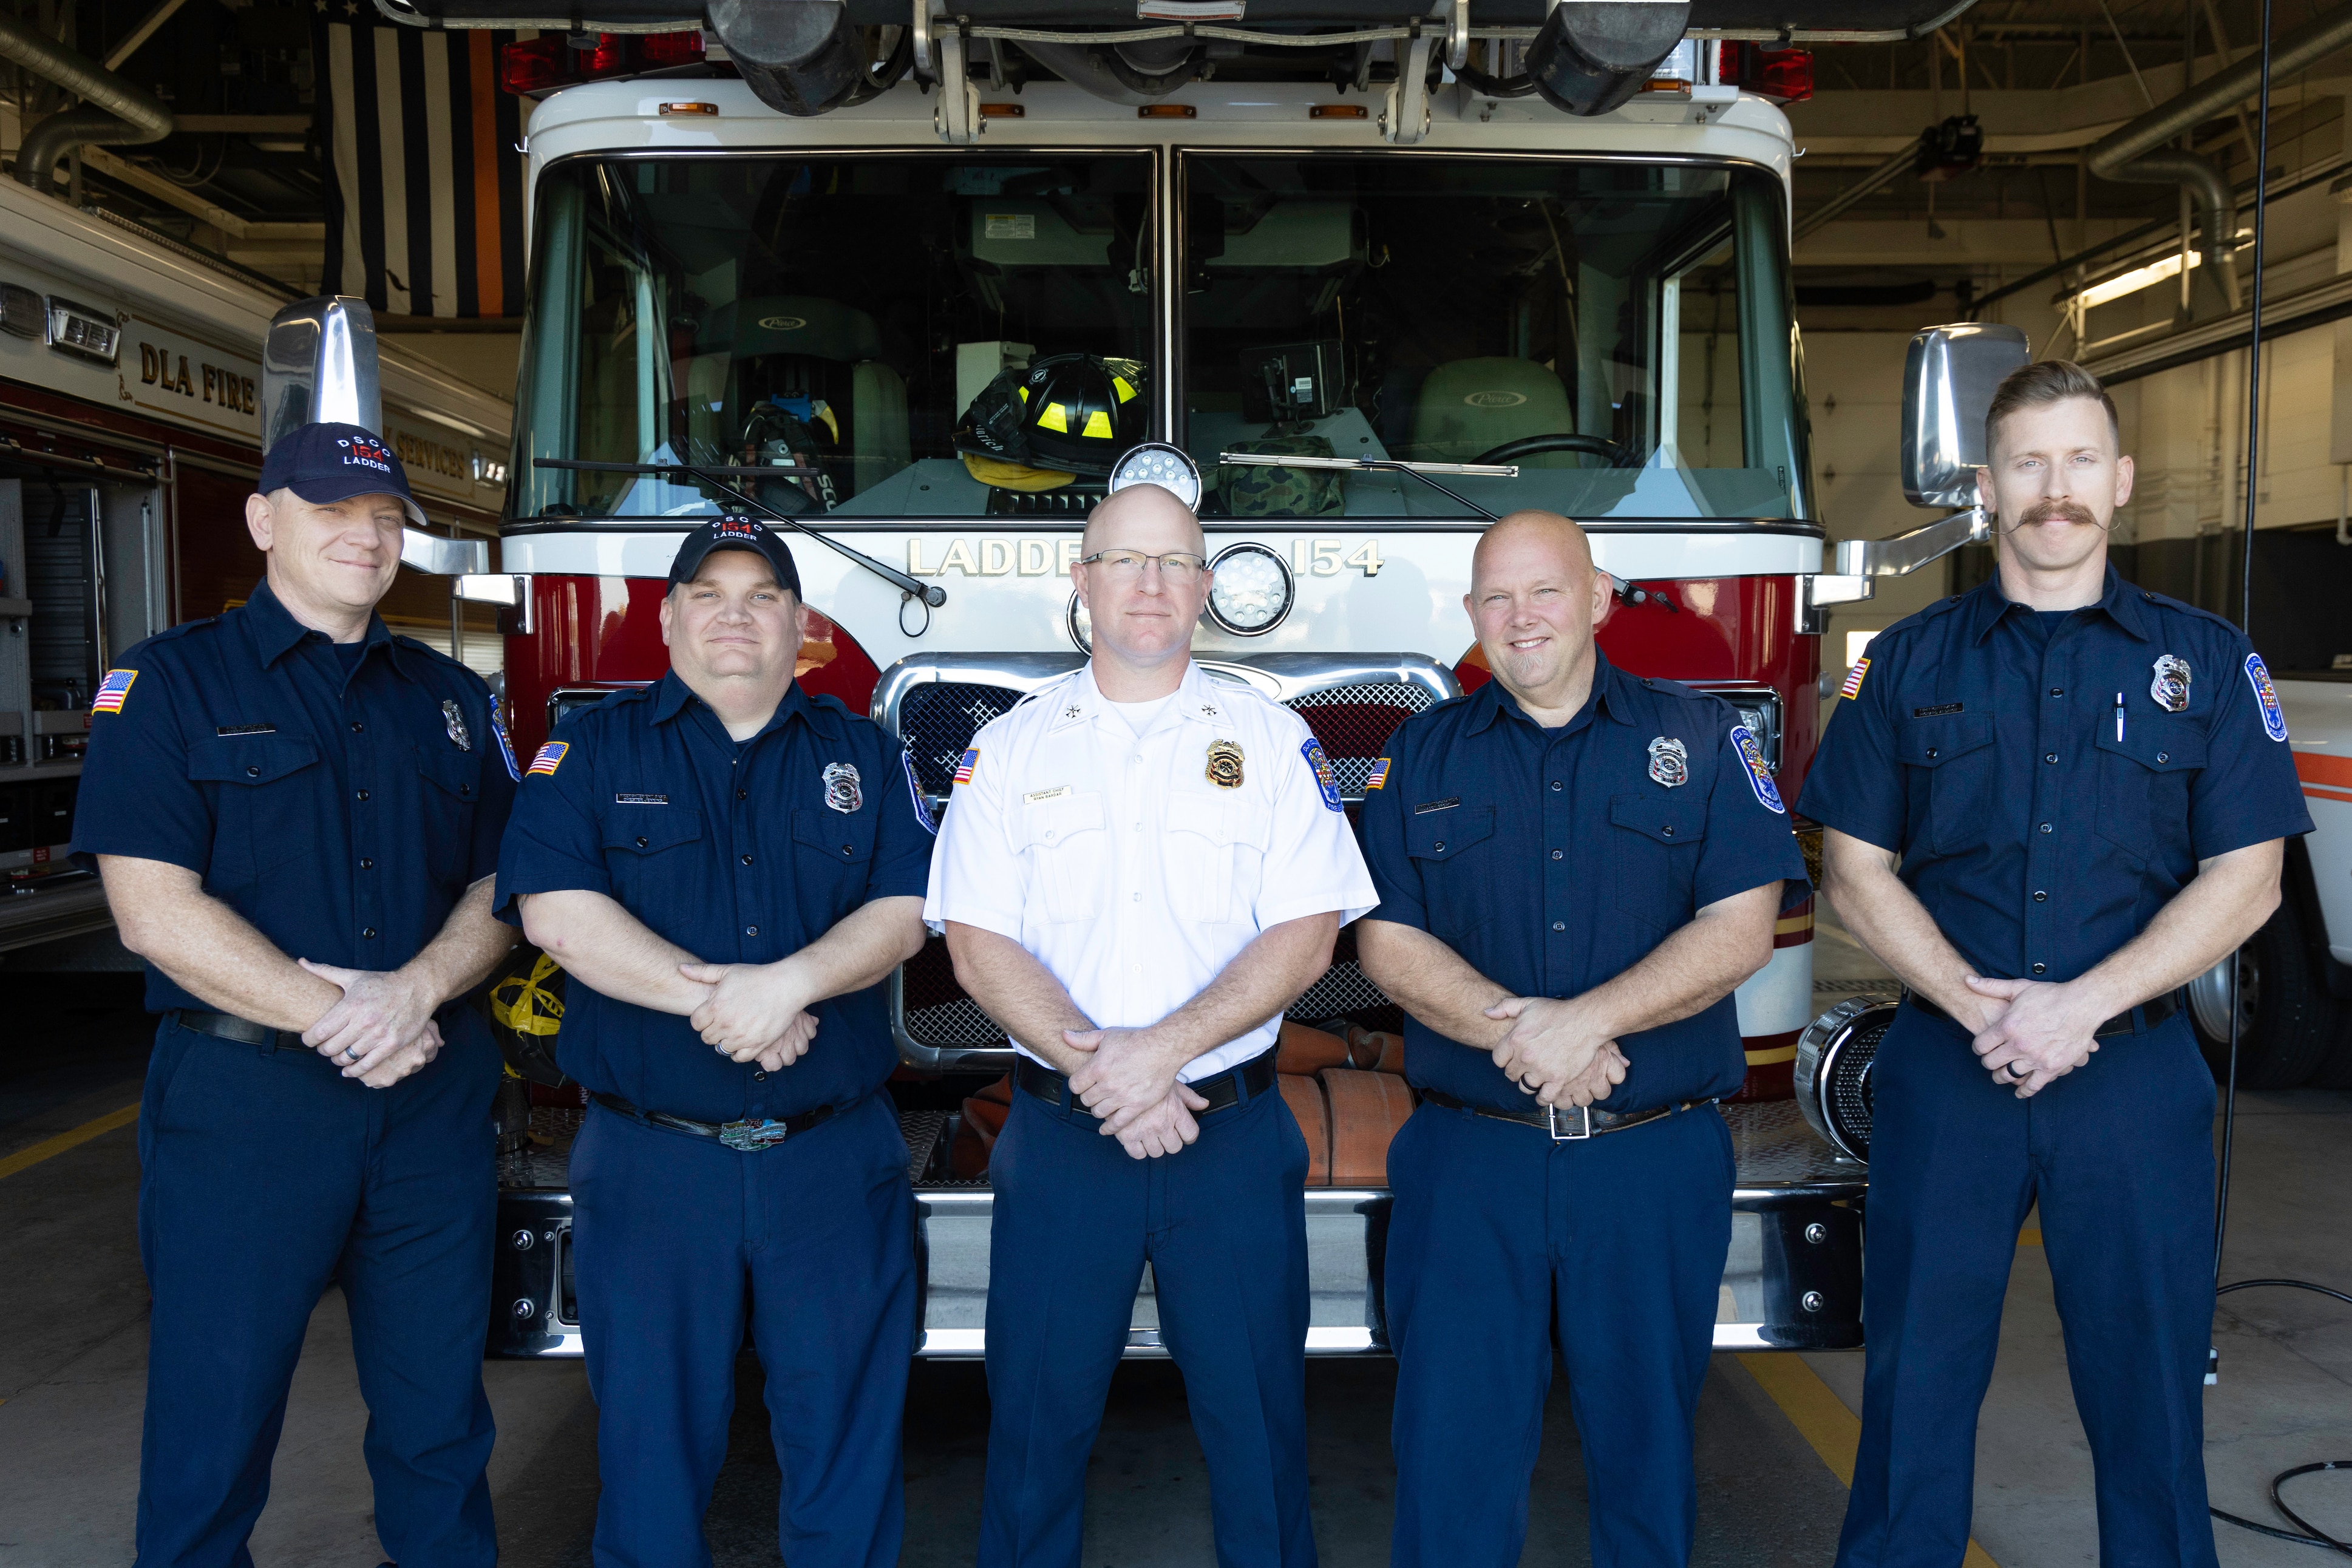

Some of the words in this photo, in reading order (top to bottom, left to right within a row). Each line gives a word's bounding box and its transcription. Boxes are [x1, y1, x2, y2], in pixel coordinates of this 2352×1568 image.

[139, 341, 194, 397] DLA
[202, 363, 255, 416] FIRE
[1477, 393, 1512, 404] Pierce
[352, 445, 384, 462] 154
[396, 430, 465, 480] SERVICES
[344, 456, 390, 473] LADDER
[713, 531, 757, 541] LADDER
[722, 522, 752, 534] 154
[906, 538, 1083, 577] LADDE
[1291, 538, 1385, 577] 154
